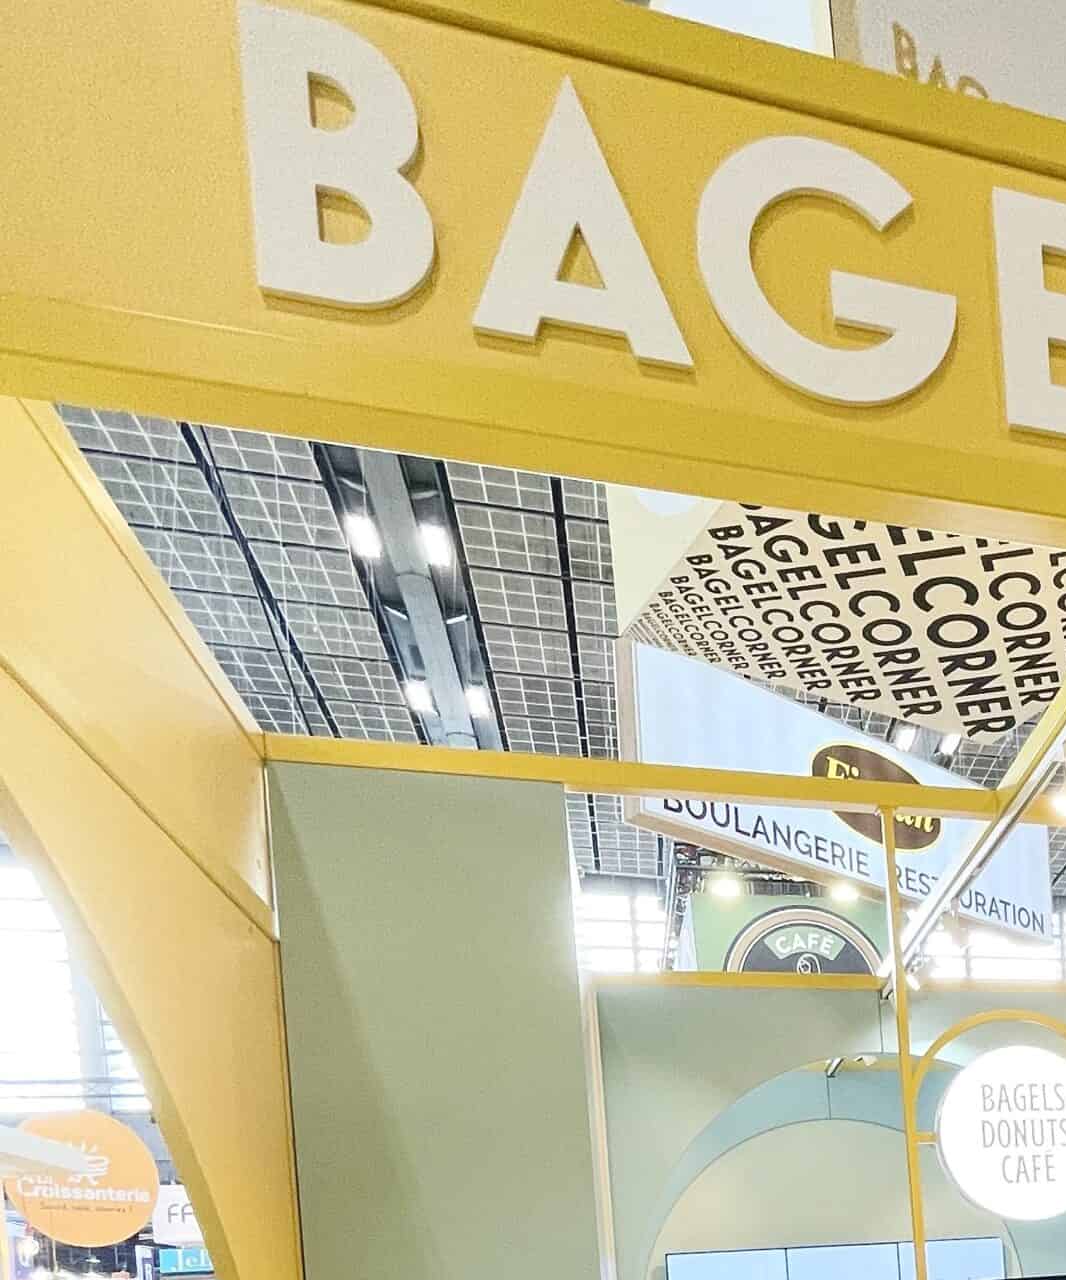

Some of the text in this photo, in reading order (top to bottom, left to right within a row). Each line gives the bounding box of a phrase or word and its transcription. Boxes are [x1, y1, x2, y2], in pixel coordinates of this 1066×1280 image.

[658, 592, 721, 663] BAGELCORNER
[670, 576, 750, 670] BAGELCORNER
[686, 554, 787, 680] BAGELCORNER
[708, 525, 832, 691] BAGELCORNER
[739, 503, 882, 703] AGELCORNER
[807, 513, 942, 718] GELCORNER
[887, 525, 1016, 738] LCORNER
[896, 865, 1045, 934] RESURATION
[775, 934, 834, 955] CAFÉ
[980, 1083, 1066, 1113] BAGELS
[17, 1177, 150, 1203] Croissanterie
[1002, 1151, 1057, 1184] CAFÉ
